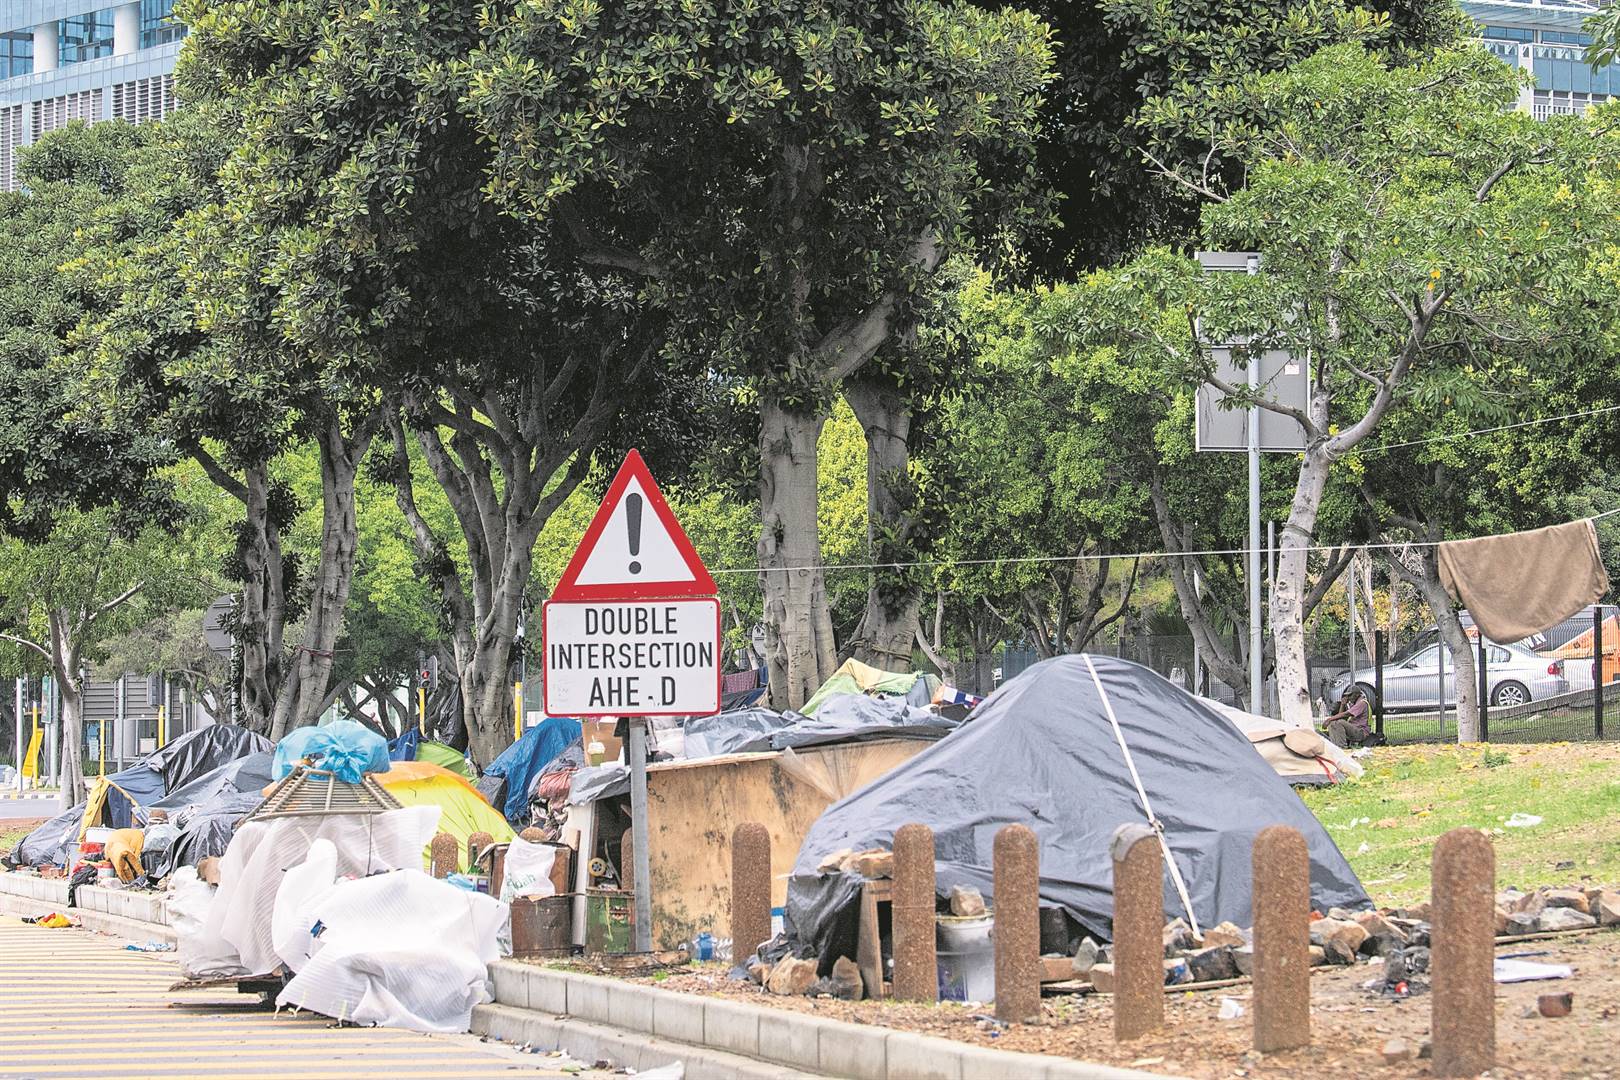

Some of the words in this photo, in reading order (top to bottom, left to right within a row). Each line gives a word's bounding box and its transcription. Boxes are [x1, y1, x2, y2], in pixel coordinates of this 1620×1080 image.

[585, 606, 678, 636] DOUBLE
[551, 641, 714, 670] INTERSECTION
[588, 675, 677, 707] AHED
